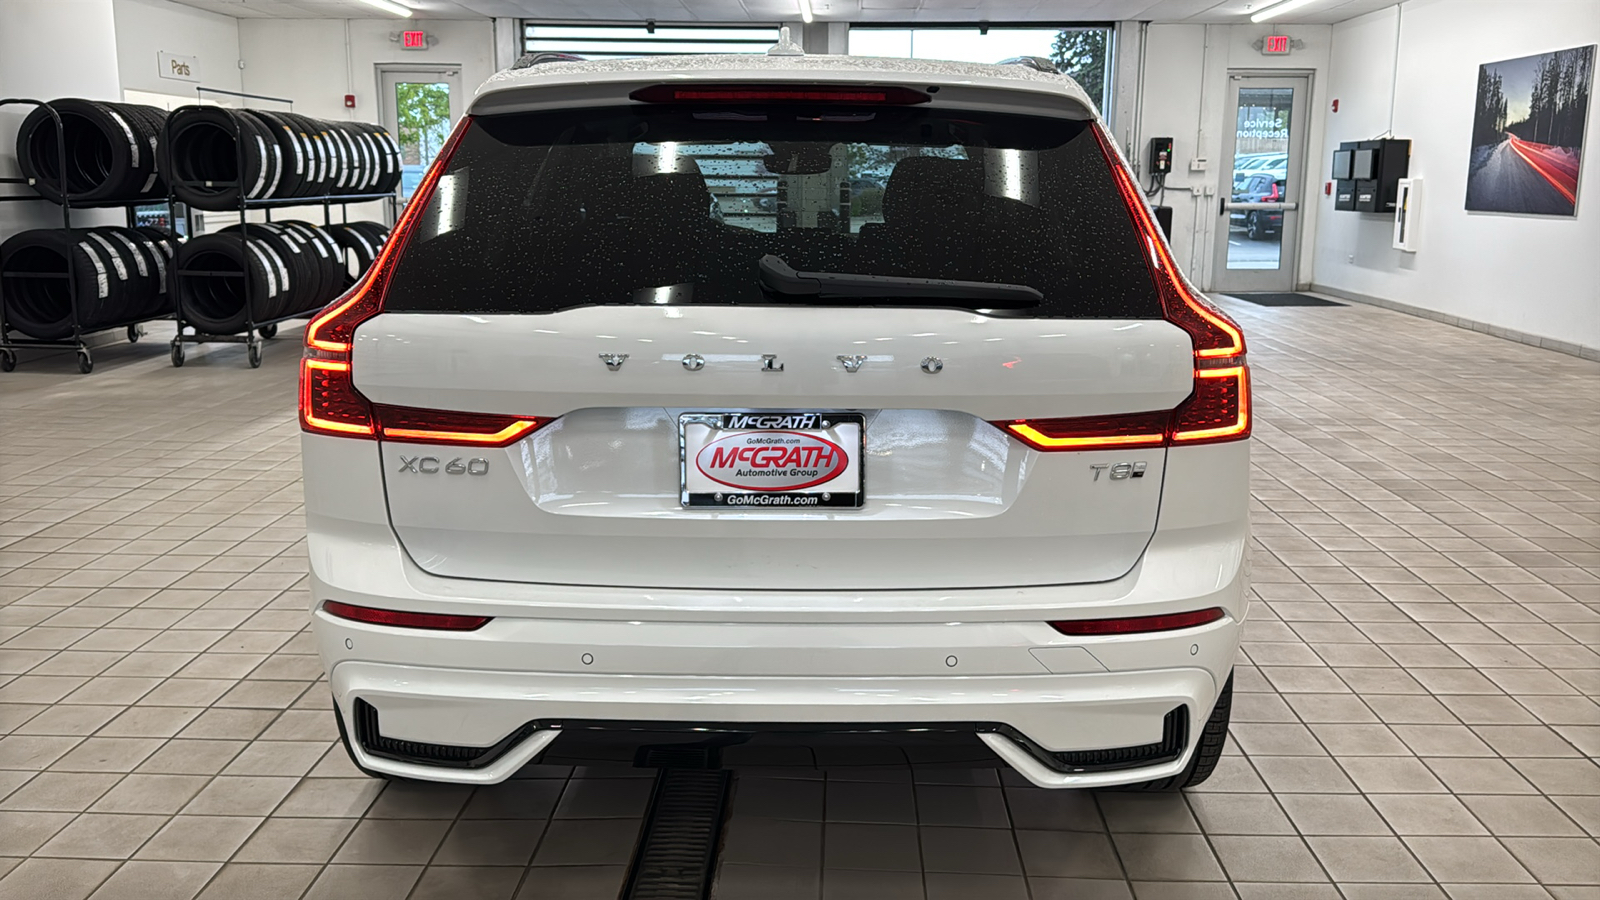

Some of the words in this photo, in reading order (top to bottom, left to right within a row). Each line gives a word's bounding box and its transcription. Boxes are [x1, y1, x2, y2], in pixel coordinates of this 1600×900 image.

[404, 31, 424, 47] EXIT
[1267, 36, 1288, 52] EXIT
[171, 59, 191, 77] Parts
[746, 437, 801, 445] GoMcGrath.com
[735, 468, 788, 477] Automotive
[790, 468, 819, 478] Group
[726, 494, 818, 506] GoMcGrath.com
